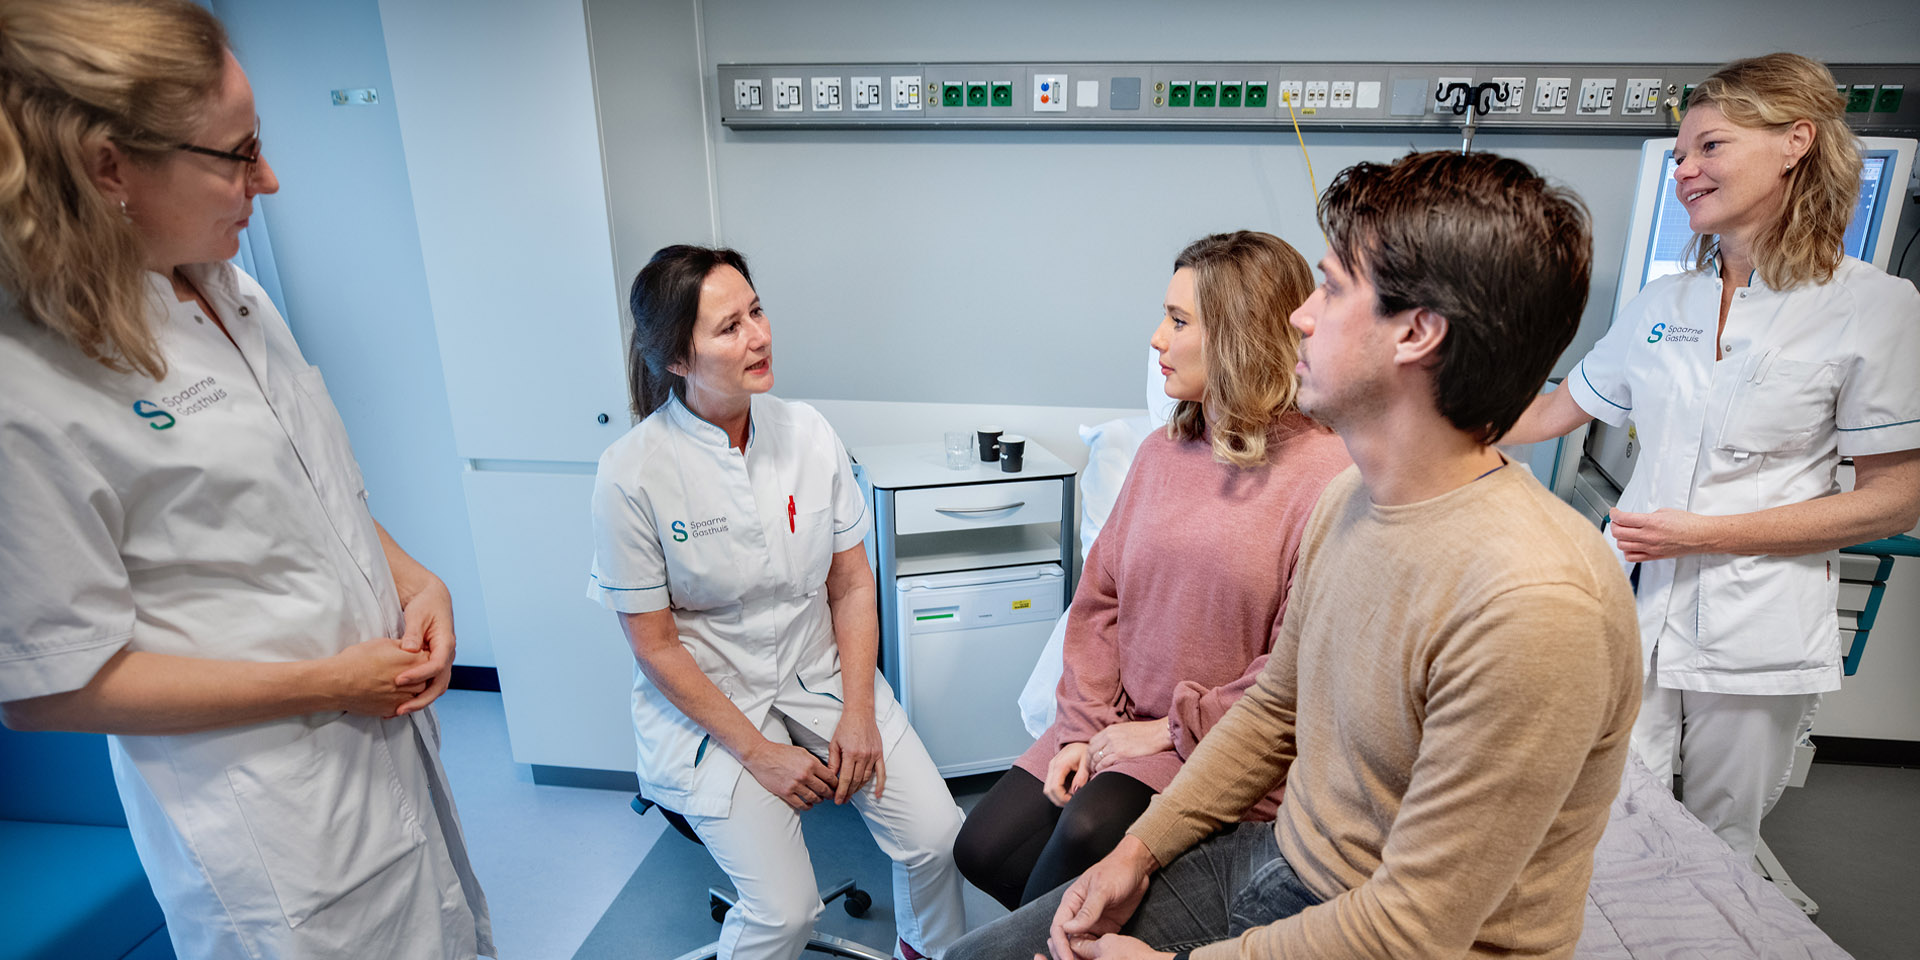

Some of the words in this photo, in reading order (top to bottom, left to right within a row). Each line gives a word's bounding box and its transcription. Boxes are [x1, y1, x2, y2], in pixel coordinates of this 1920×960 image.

[1667, 325, 1704, 335] Spaarne
[1665, 334, 1700, 343] Gasthuis
[162, 376, 216, 407] Spaarne
[176, 388, 228, 416] Gasthuis
[690, 516, 727, 530] Spaarne
[692, 524, 729, 539] Gasthuis
